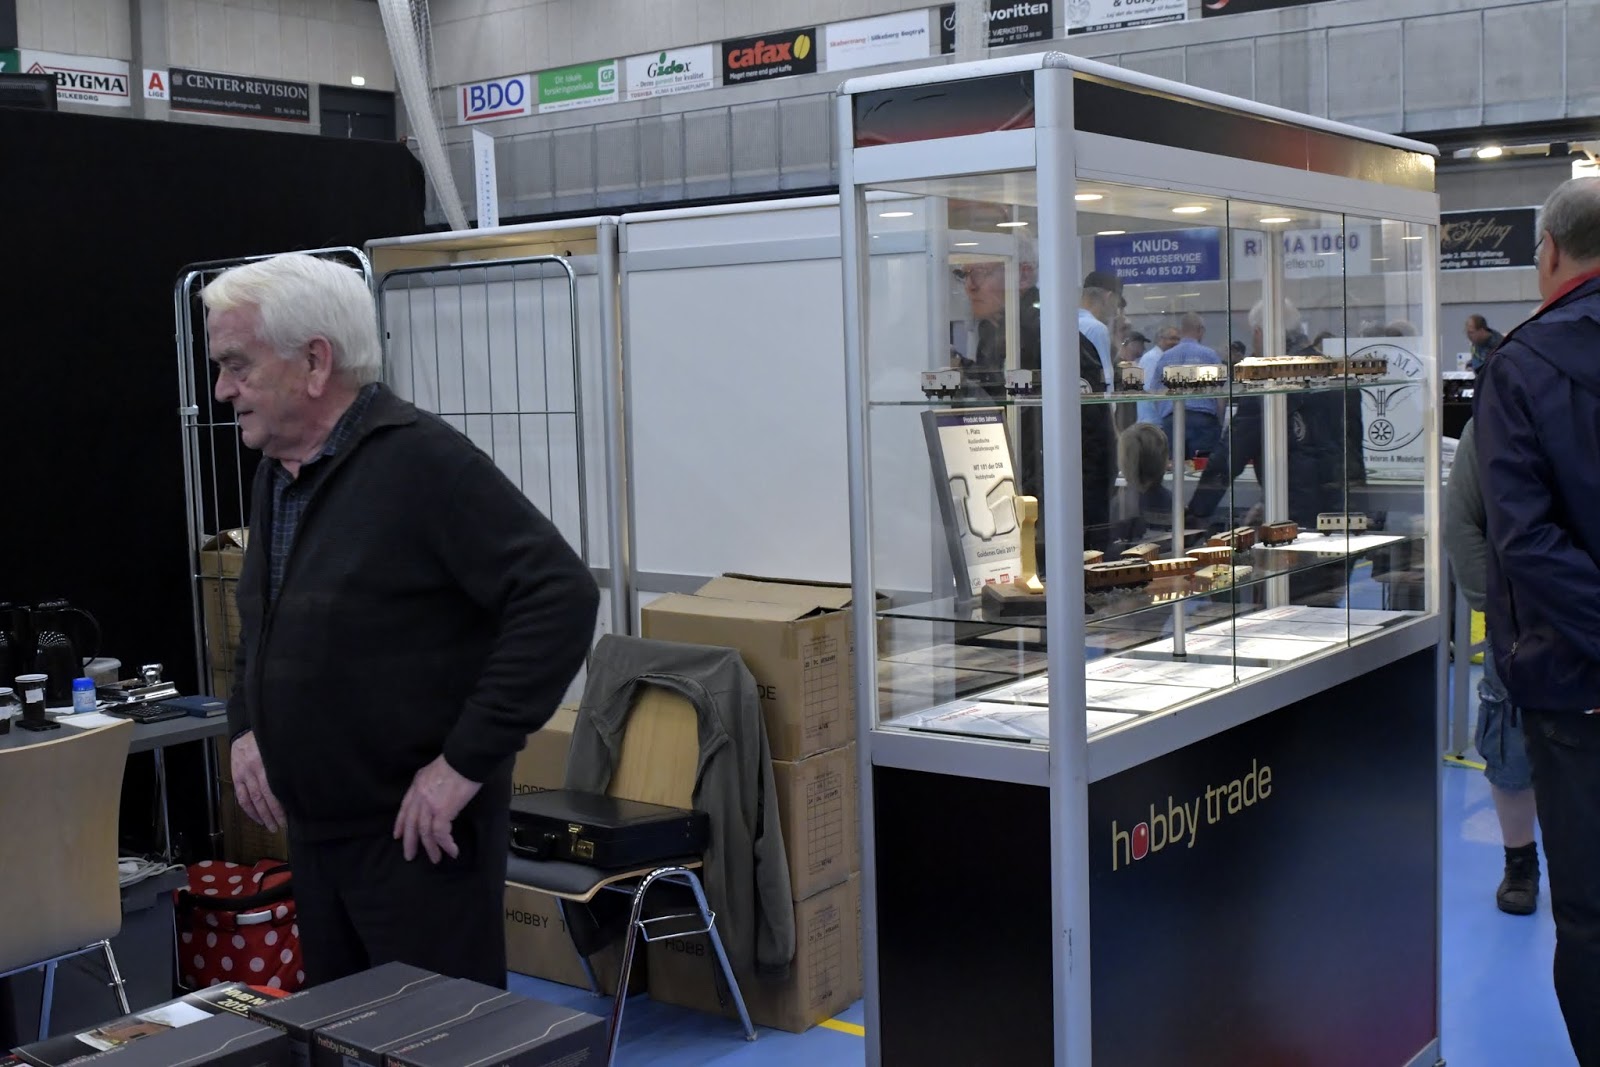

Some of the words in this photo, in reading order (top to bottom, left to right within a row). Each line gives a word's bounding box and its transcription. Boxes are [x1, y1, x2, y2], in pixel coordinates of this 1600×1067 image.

[982, 2, 1048, 22] voritten
[992, 25, 1028, 36] VÆRKSTED
[728, 40, 792, 69] cafax
[602, 70, 613, 80] GF
[769, 67, 778, 75] god
[779, 64, 792, 72] kaffe
[56, 72, 125, 92] BYGMA
[148, 72, 164, 92] A
[57, 92, 99, 101] SILKEBORG
[470, 79, 524, 112] BDO
[631, 91, 652, 99] TOSHIBA
[1452, 217, 1514, 250] Styling
[1132, 239, 1179, 253] KNUDs
[1244, 236, 1304, 256] RA
[1311, 232, 1359, 252] 1000
[1111, 253, 1202, 266] HVIDEVARESERVICE
[1286, 259, 1325, 269] ellerup
[1117, 268, 1138, 277] RING
[1146, 267, 1157, 276] 40
[1172, 266, 1183, 275] 02
[1186, 265, 1196, 274] 78
[977, 550, 996, 558] Goldenes
[1112, 796, 1200, 871] hobby
[1204, 758, 1272, 825] trade
[506, 908, 549, 928] HOBBY
[665, 939, 704, 956] HOBB
[318, 1036, 339, 1050] hobby
[340, 1044, 359, 1058] trade
